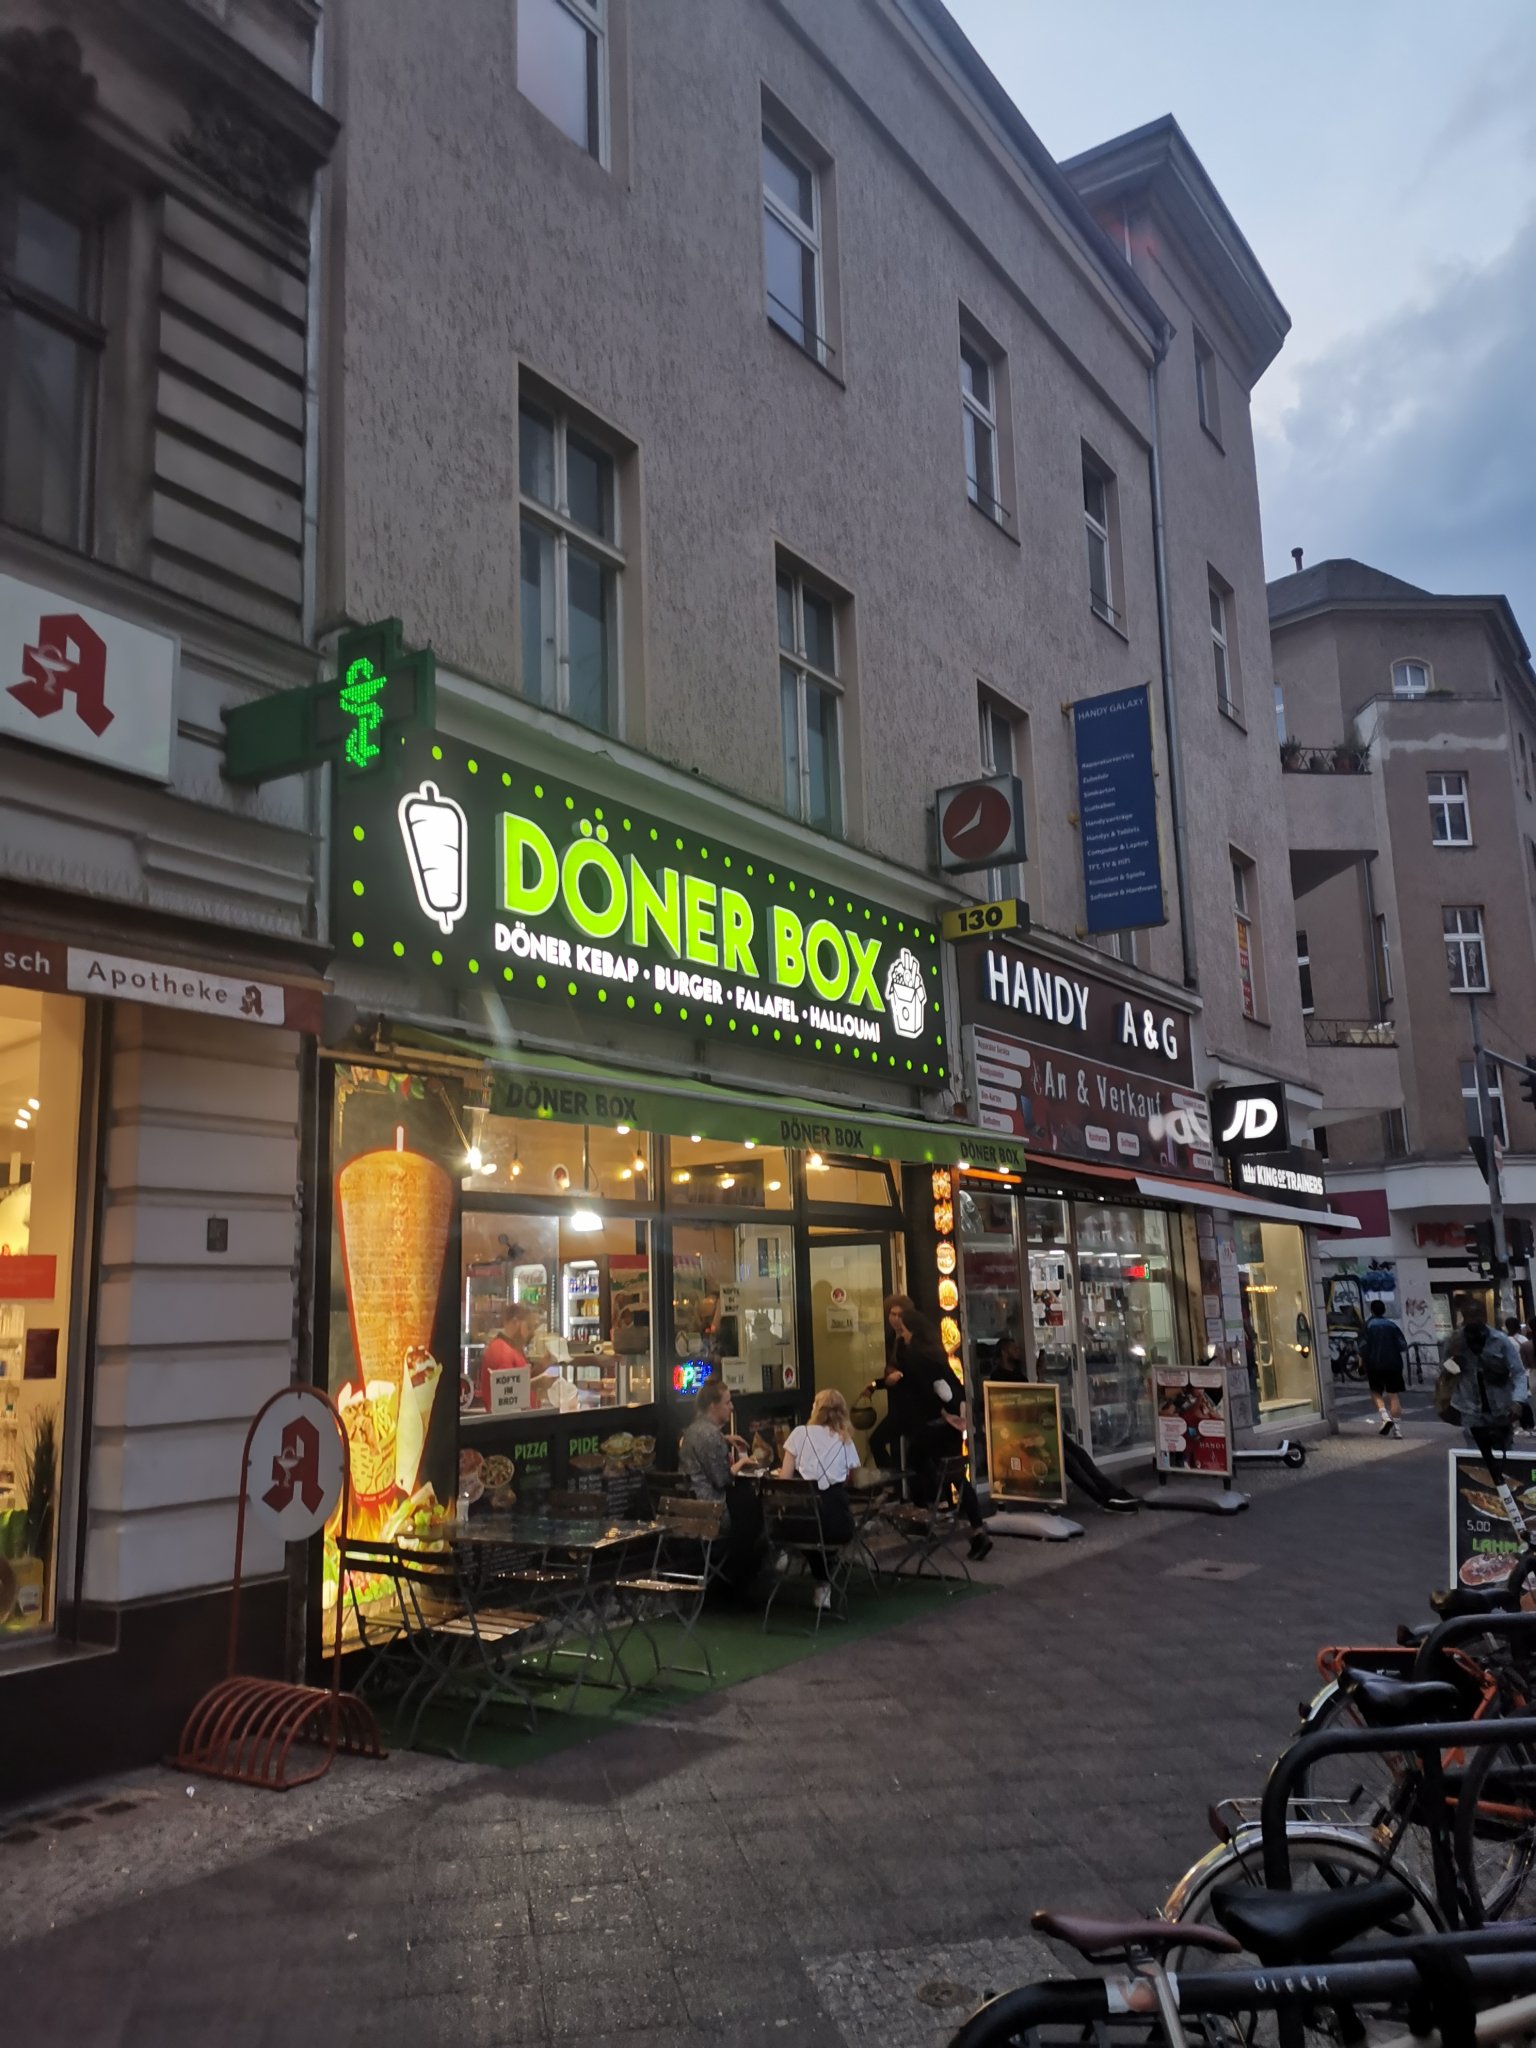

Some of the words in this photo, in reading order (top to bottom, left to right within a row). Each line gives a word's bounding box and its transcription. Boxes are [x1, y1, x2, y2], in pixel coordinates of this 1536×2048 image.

[1078, 705, 1108, 721] HANDY
[1109, 698, 1145, 713] GALAXY
[1102, 861, 1110, 869] TV
[499, 810, 760, 978] DÖNER
[768, 904, 886, 1013] BOX
[958, 906, 1003, 932] 130
[3, 949, 50, 975] sch
[87, 959, 228, 1004] Apotheke
[494, 922, 571, 968] DÖNER
[576, 945, 639, 984] KEBAP
[654, 964, 723, 1005] BURGER
[735, 985, 799, 1023] FALAFEL
[809, 1005, 880, 1043] HALLOUMI
[986, 950, 1089, 1031] HANDY
[505, 1082, 590, 1113] DÖNER
[594, 1094, 638, 1122] BOX
[1045, 1061, 1067, 1099] An
[1077, 1069, 1090, 1107] &
[1096, 1074, 1160, 1118] Verkauf
[780, 1118, 831, 1145] DÖNER
[835, 1126, 864, 1149] BOX
[1222, 1097, 1278, 1142] JD
[960, 1141, 997, 1161] DÖNER
[999, 1147, 1021, 1165] BOX
[1257, 1164, 1278, 1187] KING
[1278, 1168, 1286, 1184] OF
[1286, 1170, 1324, 1195] TRAINERS
[514, 1441, 548, 1460] PIZZA
[569, 1435, 599, 1457] PIDE
[1472, 1538, 1520, 1553] LAHM
